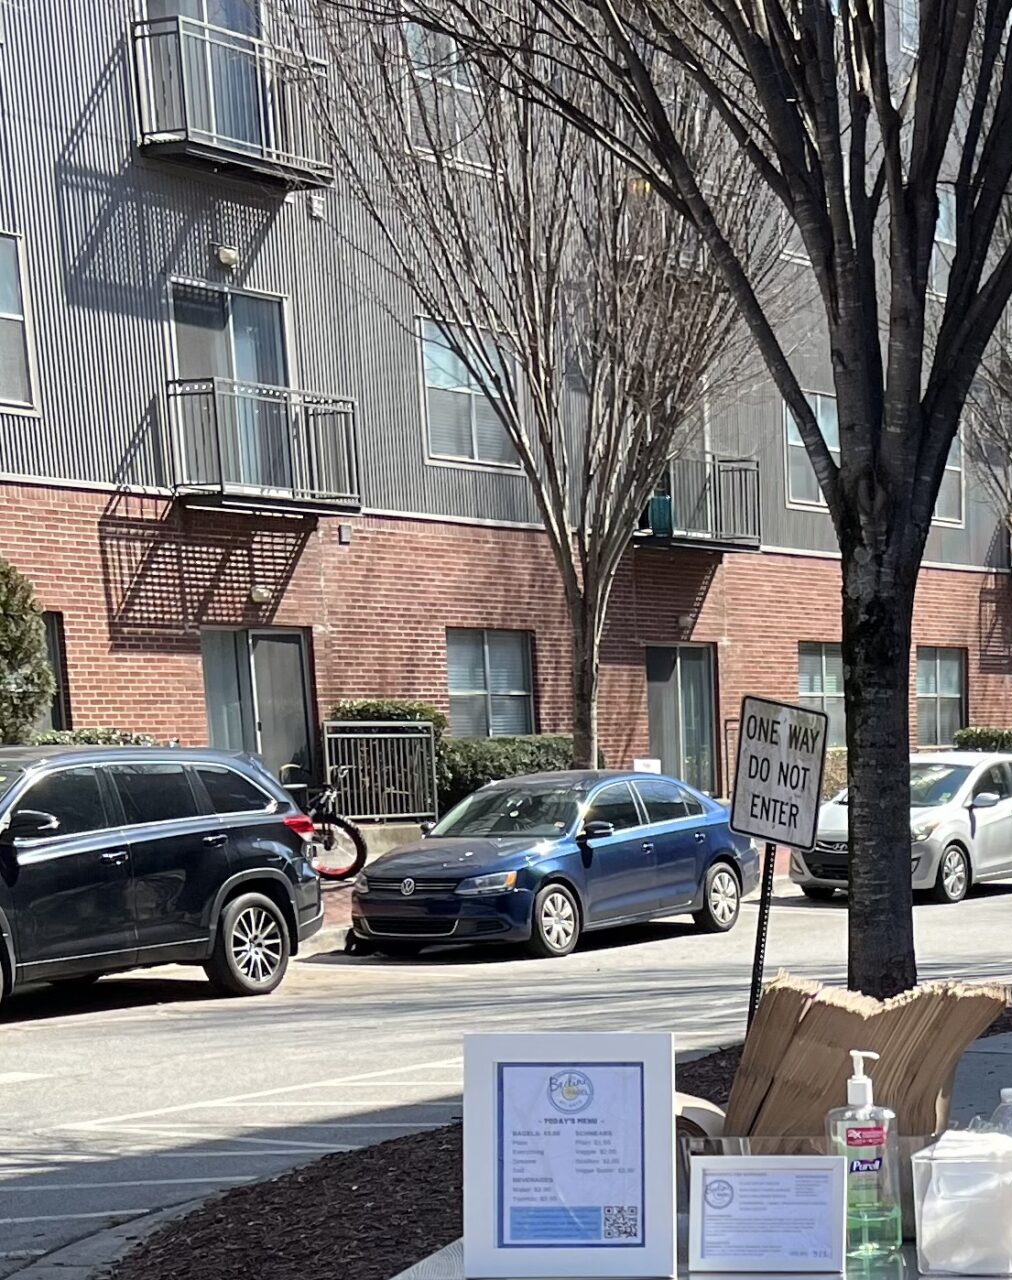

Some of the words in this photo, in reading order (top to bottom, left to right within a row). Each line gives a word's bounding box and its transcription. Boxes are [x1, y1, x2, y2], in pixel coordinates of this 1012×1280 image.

[746, 714, 781, 746] ONE
[789, 723, 820, 754] WAY
[748, 754, 770, 782] DO
[778, 761, 810, 791] NOT
[750, 794, 800, 828] ENTER
